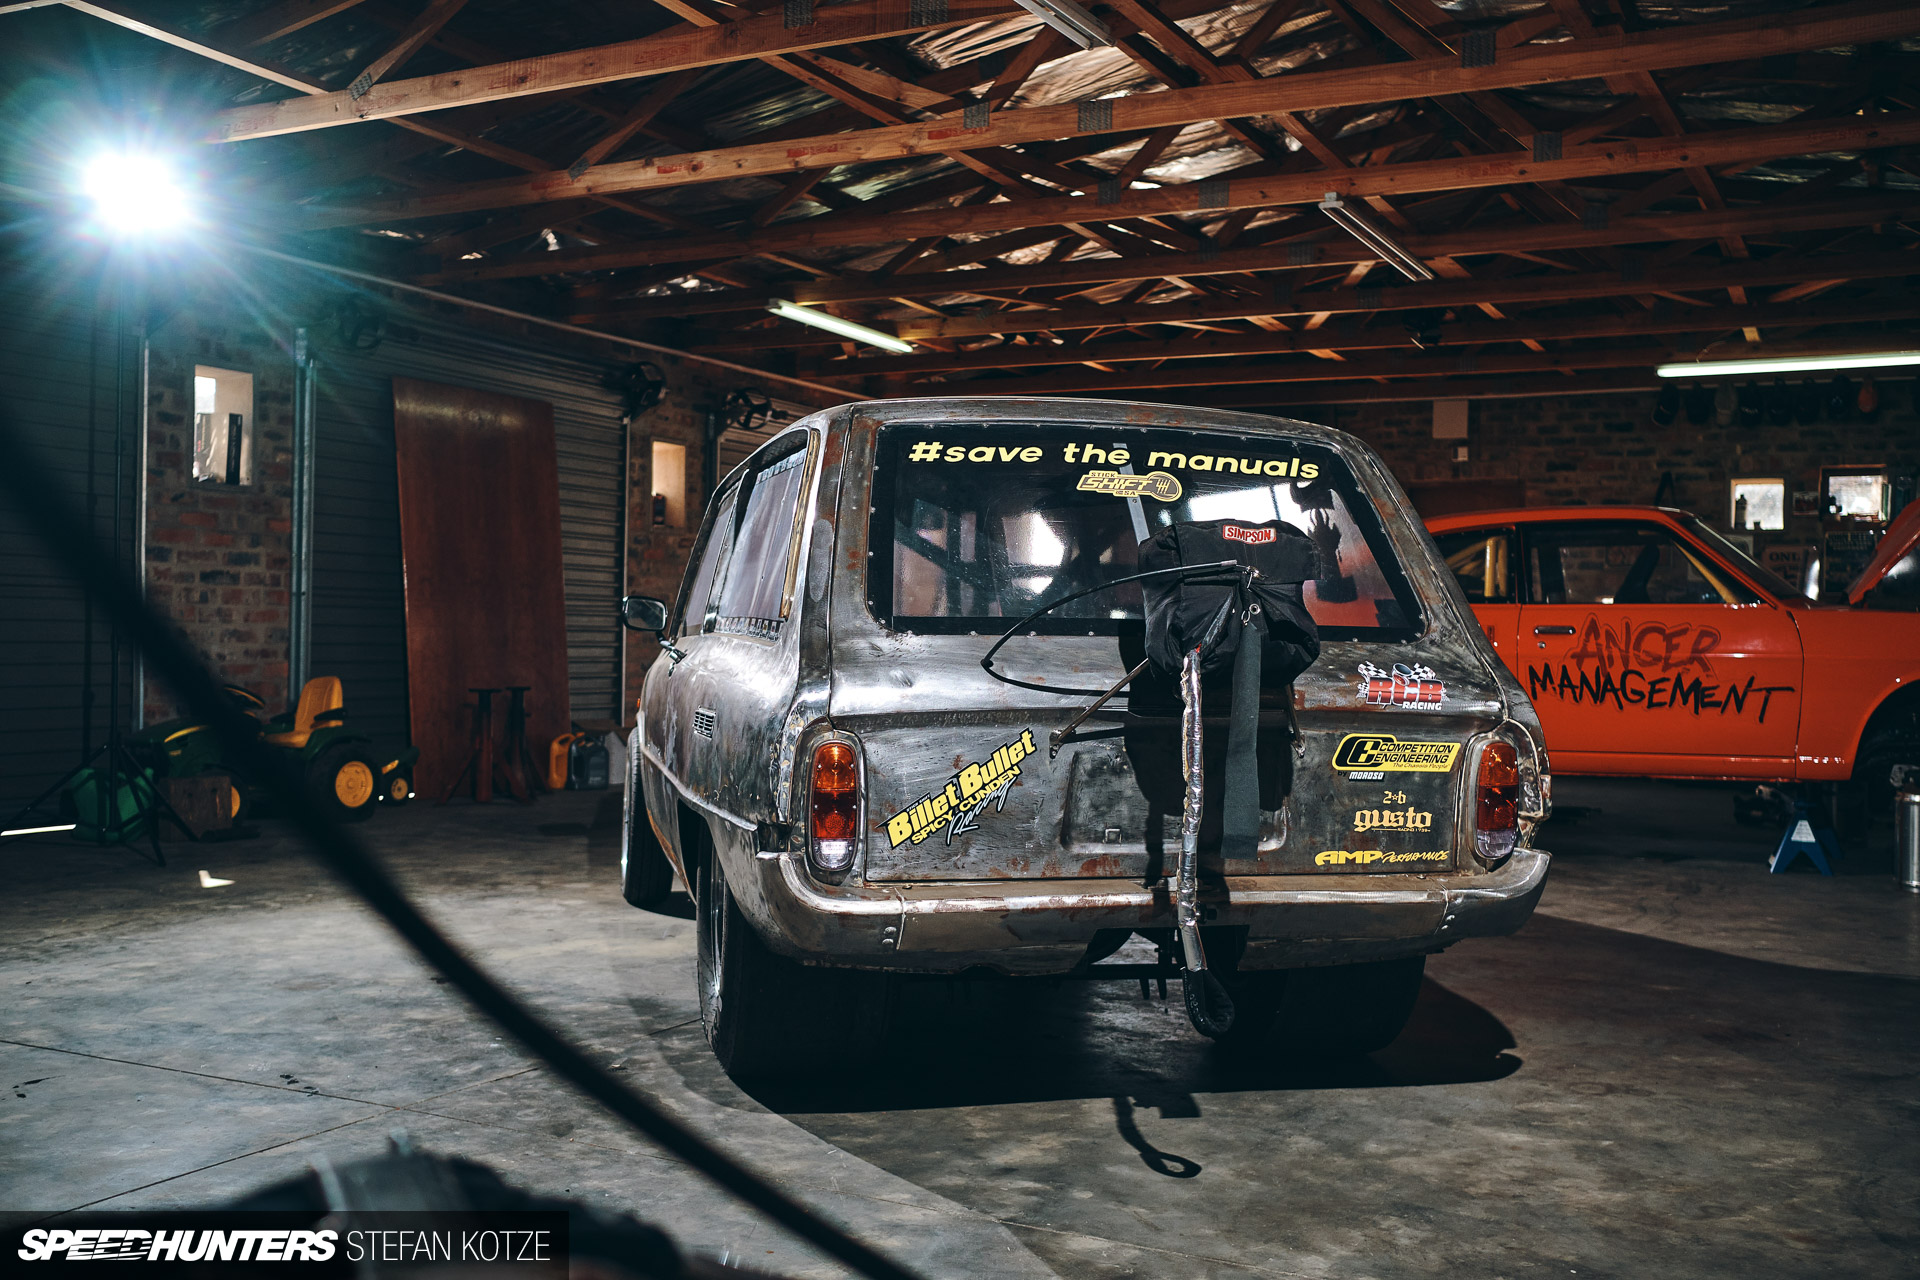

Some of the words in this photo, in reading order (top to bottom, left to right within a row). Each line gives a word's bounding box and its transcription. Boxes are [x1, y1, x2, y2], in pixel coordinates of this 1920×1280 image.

[908, 441, 1043, 463] #save
[1063, 443, 1130, 465] the
[1147, 451, 1320, 479] manuals
[1082, 477, 1153, 491] SHIFT
[1226, 527, 1271, 543] SIMPSON
[1570, 616, 1720, 678] ANGER
[1528, 662, 1795, 724] MANAGEMENT
[1402, 701, 1443, 711] RACING
[1375, 753, 1450, 763] ENGINEERING
[1380, 743, 1455, 753] COMPETITION
[887, 783, 960, 848] Billet
[958, 730, 1036, 799] Bullet
[911, 811, 954, 845] SPICY
[1353, 806, 1432, 833] gusto
[1314, 850, 1383, 866] AMP
